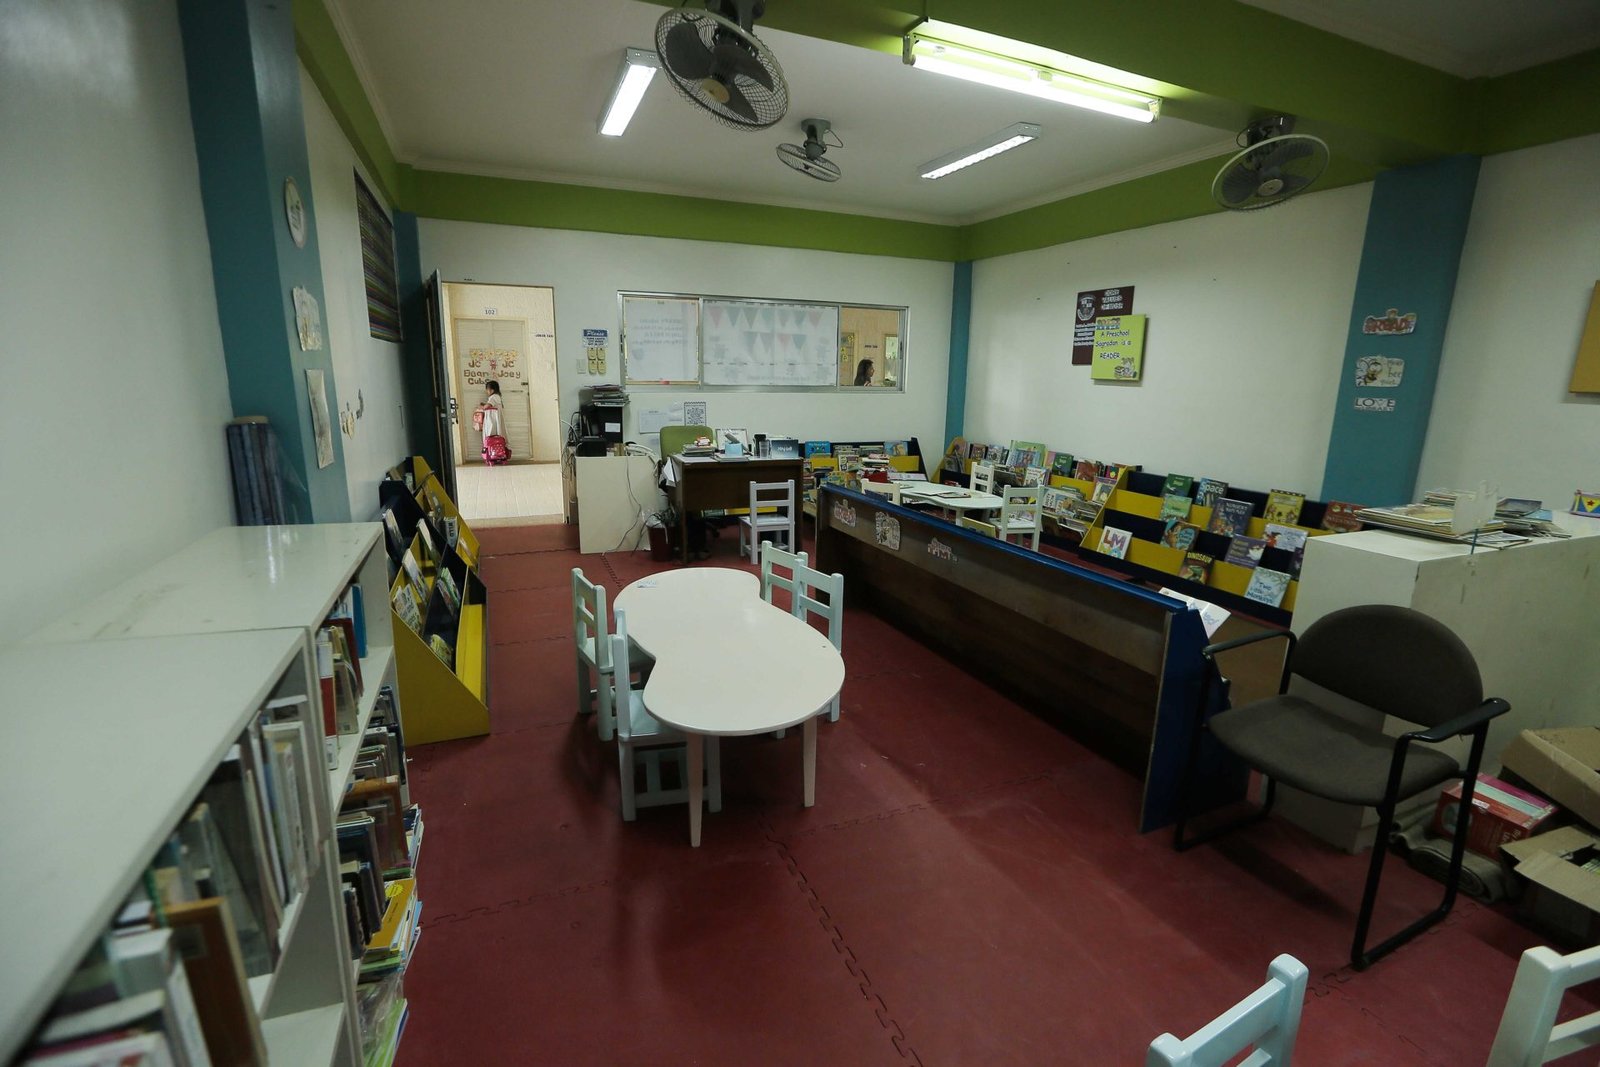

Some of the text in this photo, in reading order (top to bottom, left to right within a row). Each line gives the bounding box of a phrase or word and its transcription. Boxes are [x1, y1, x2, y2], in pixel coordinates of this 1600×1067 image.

[1106, 329, 1129, 337] Preschool
[468, 360, 481, 368] JC
[502, 360, 514, 368] JC
[497, 370, 521, 379] Joey
[1355, 398, 1395, 407] LOVE
[1200, 480, 1224, 495] Space
[1187, 552, 1213, 564] DINOSAUR
